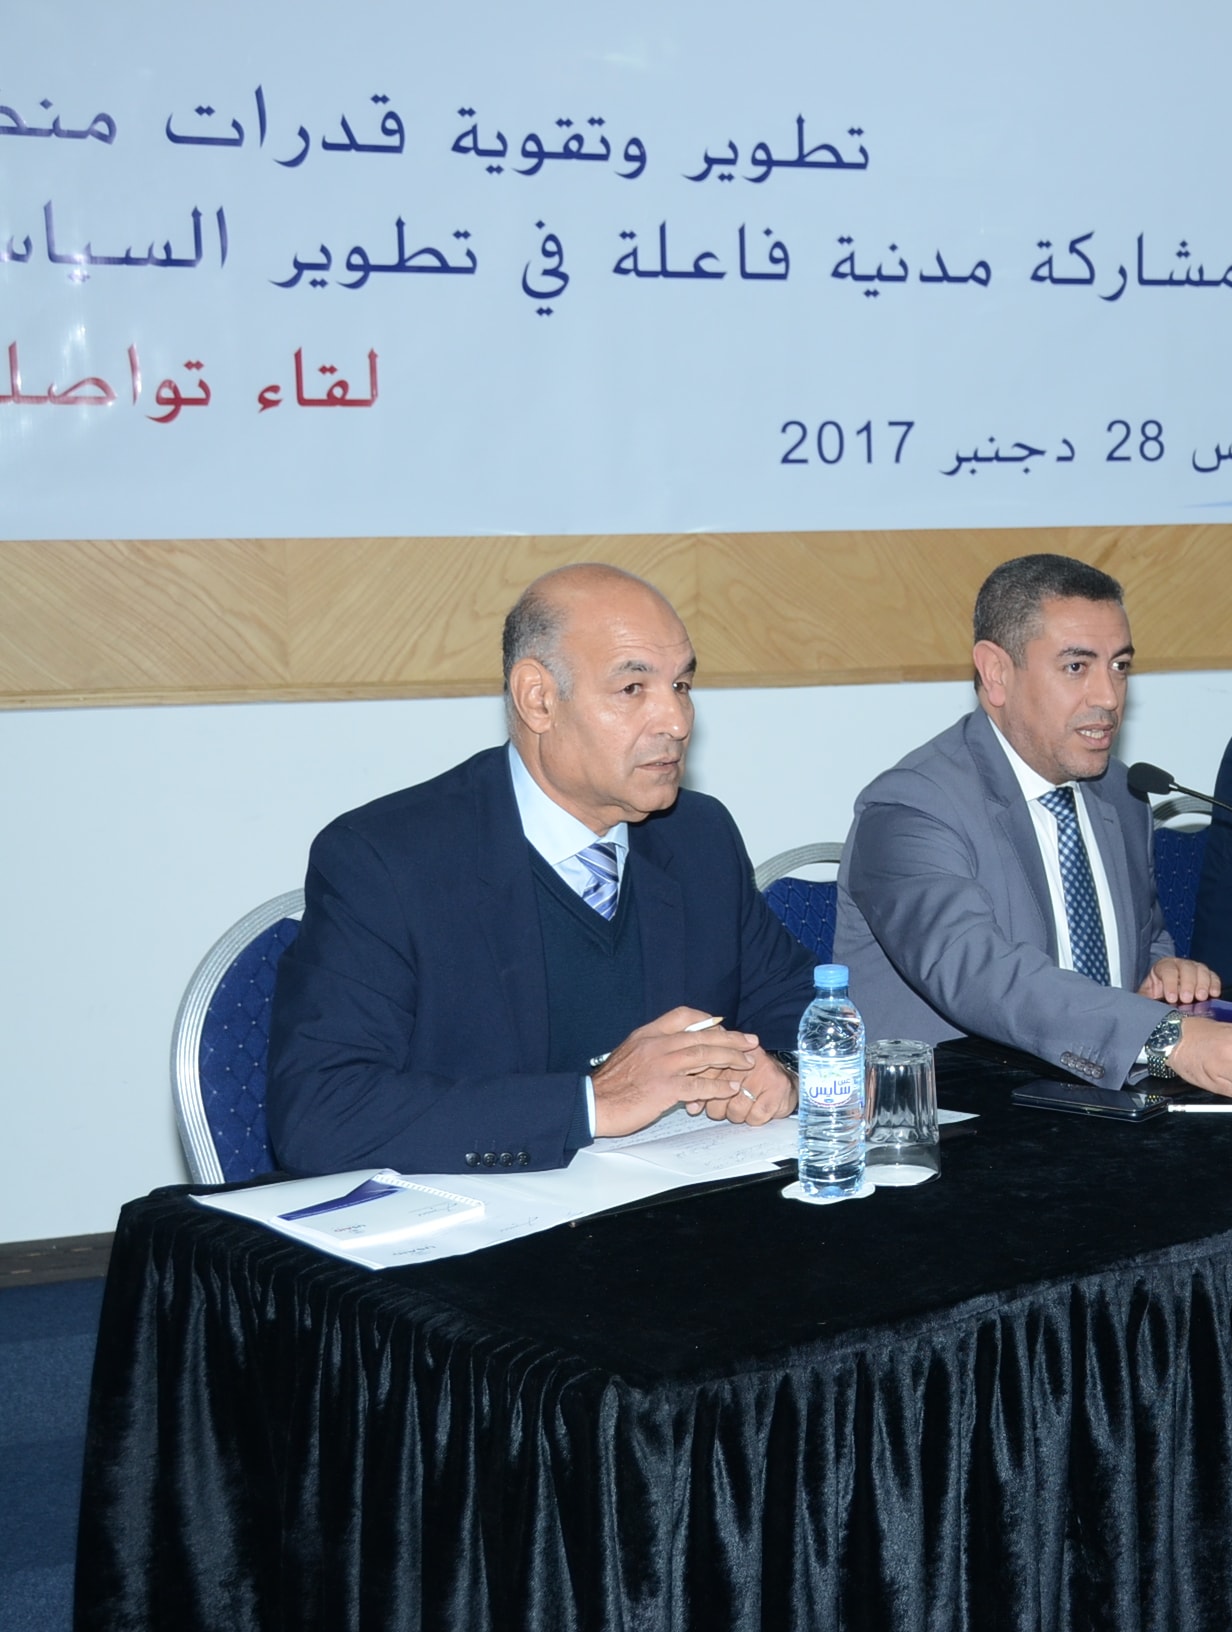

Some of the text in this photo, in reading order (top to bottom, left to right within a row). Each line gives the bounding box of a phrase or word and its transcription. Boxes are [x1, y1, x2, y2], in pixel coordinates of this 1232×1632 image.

[165, 85, 405, 168] قدرات
[451, 107, 647, 180] وتقوية
[684, 114, 869, 184] تطوير
[271, 216, 477, 290] تطوير
[521, 220, 570, 316] في
[612, 221, 790, 281] فاعلة
[830, 236, 991, 298] مدنية
[257, 347, 378, 412] لقاء
[781, 420, 915, 465] 2017
[941, 437, 1075, 476] دجنبر
[1106, 419, 1164, 462] 28
[809, 1080, 851, 1099] سايس
